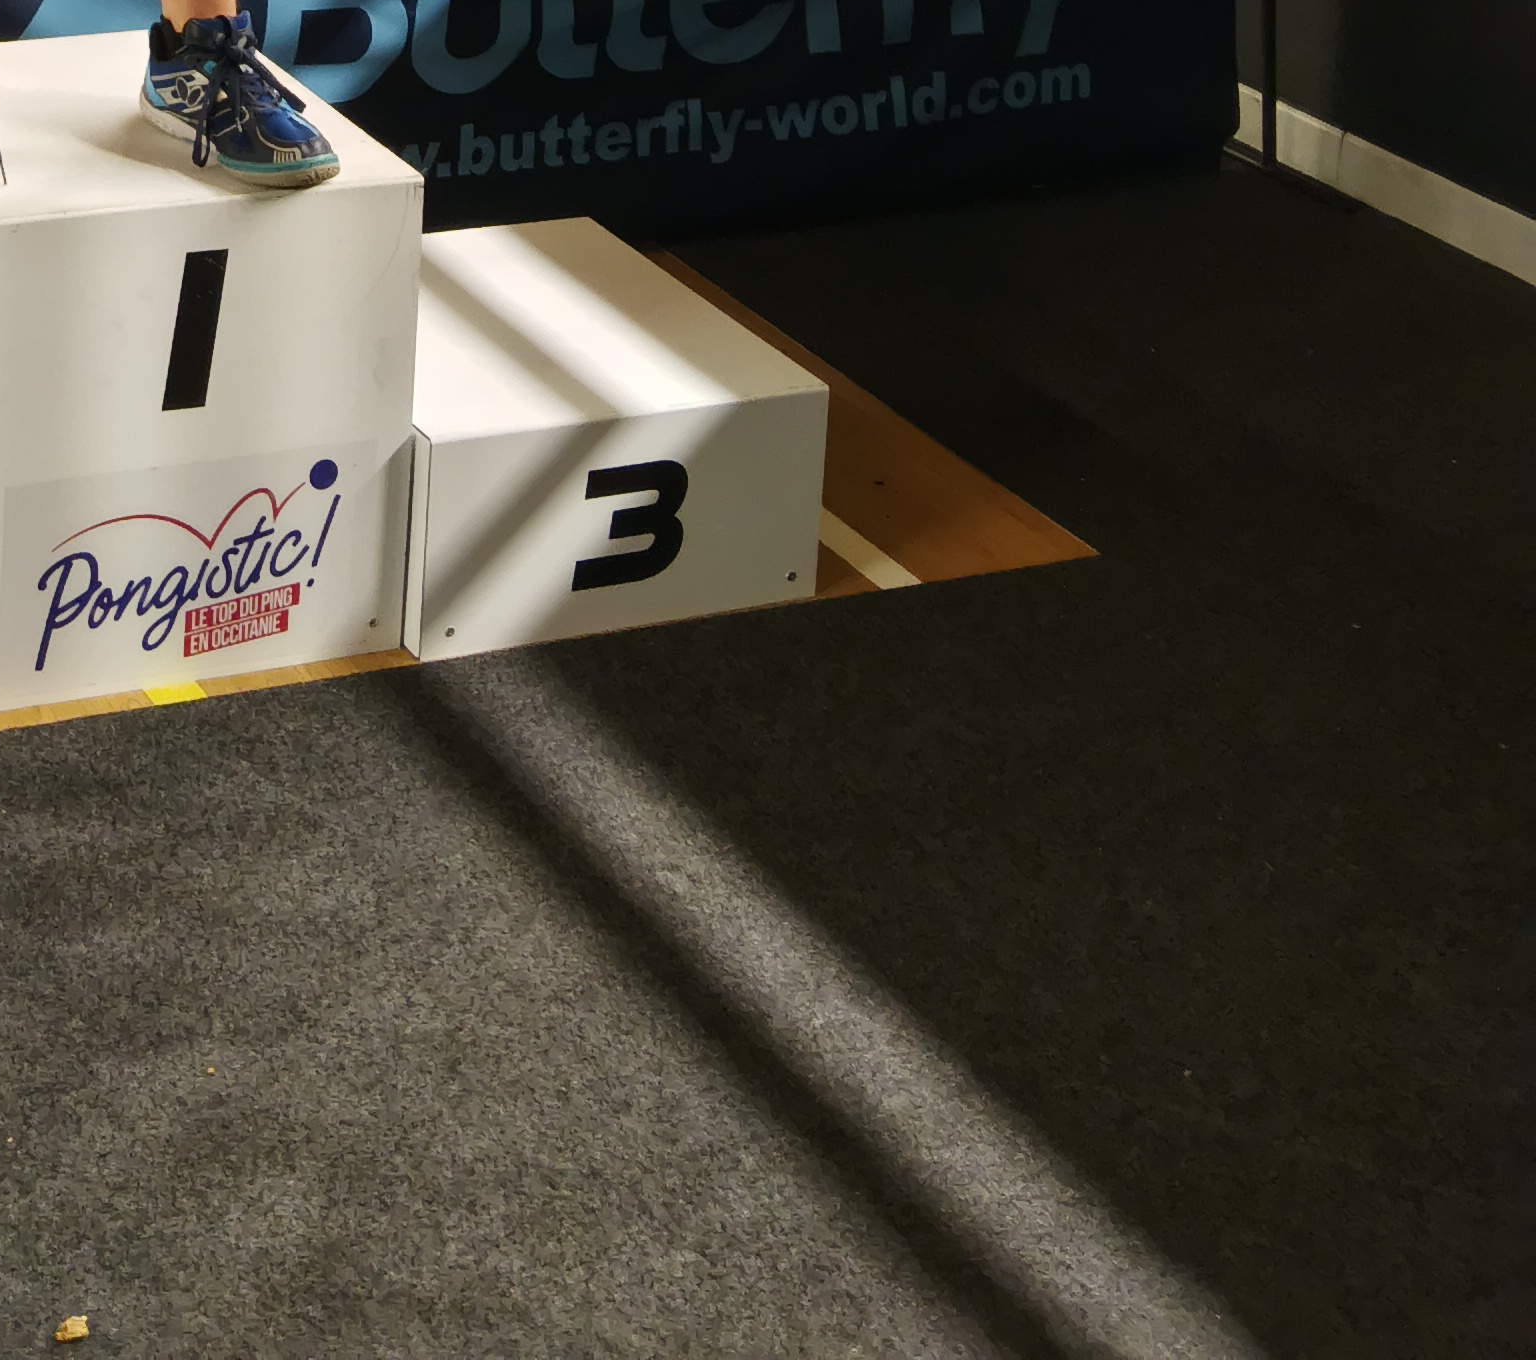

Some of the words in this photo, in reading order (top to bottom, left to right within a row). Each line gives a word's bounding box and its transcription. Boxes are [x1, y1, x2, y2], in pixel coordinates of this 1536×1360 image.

[571, 460, 689, 592] 3
[35, 493, 341, 672] Pongistic!
[191, 608, 209, 630] LE
[211, 601, 238, 625] TOP
[239, 595, 259, 618] DU
[261, 586, 293, 613] PING
[190, 631, 209, 654] EN
[211, 612, 282, 649] OCCITANIE
